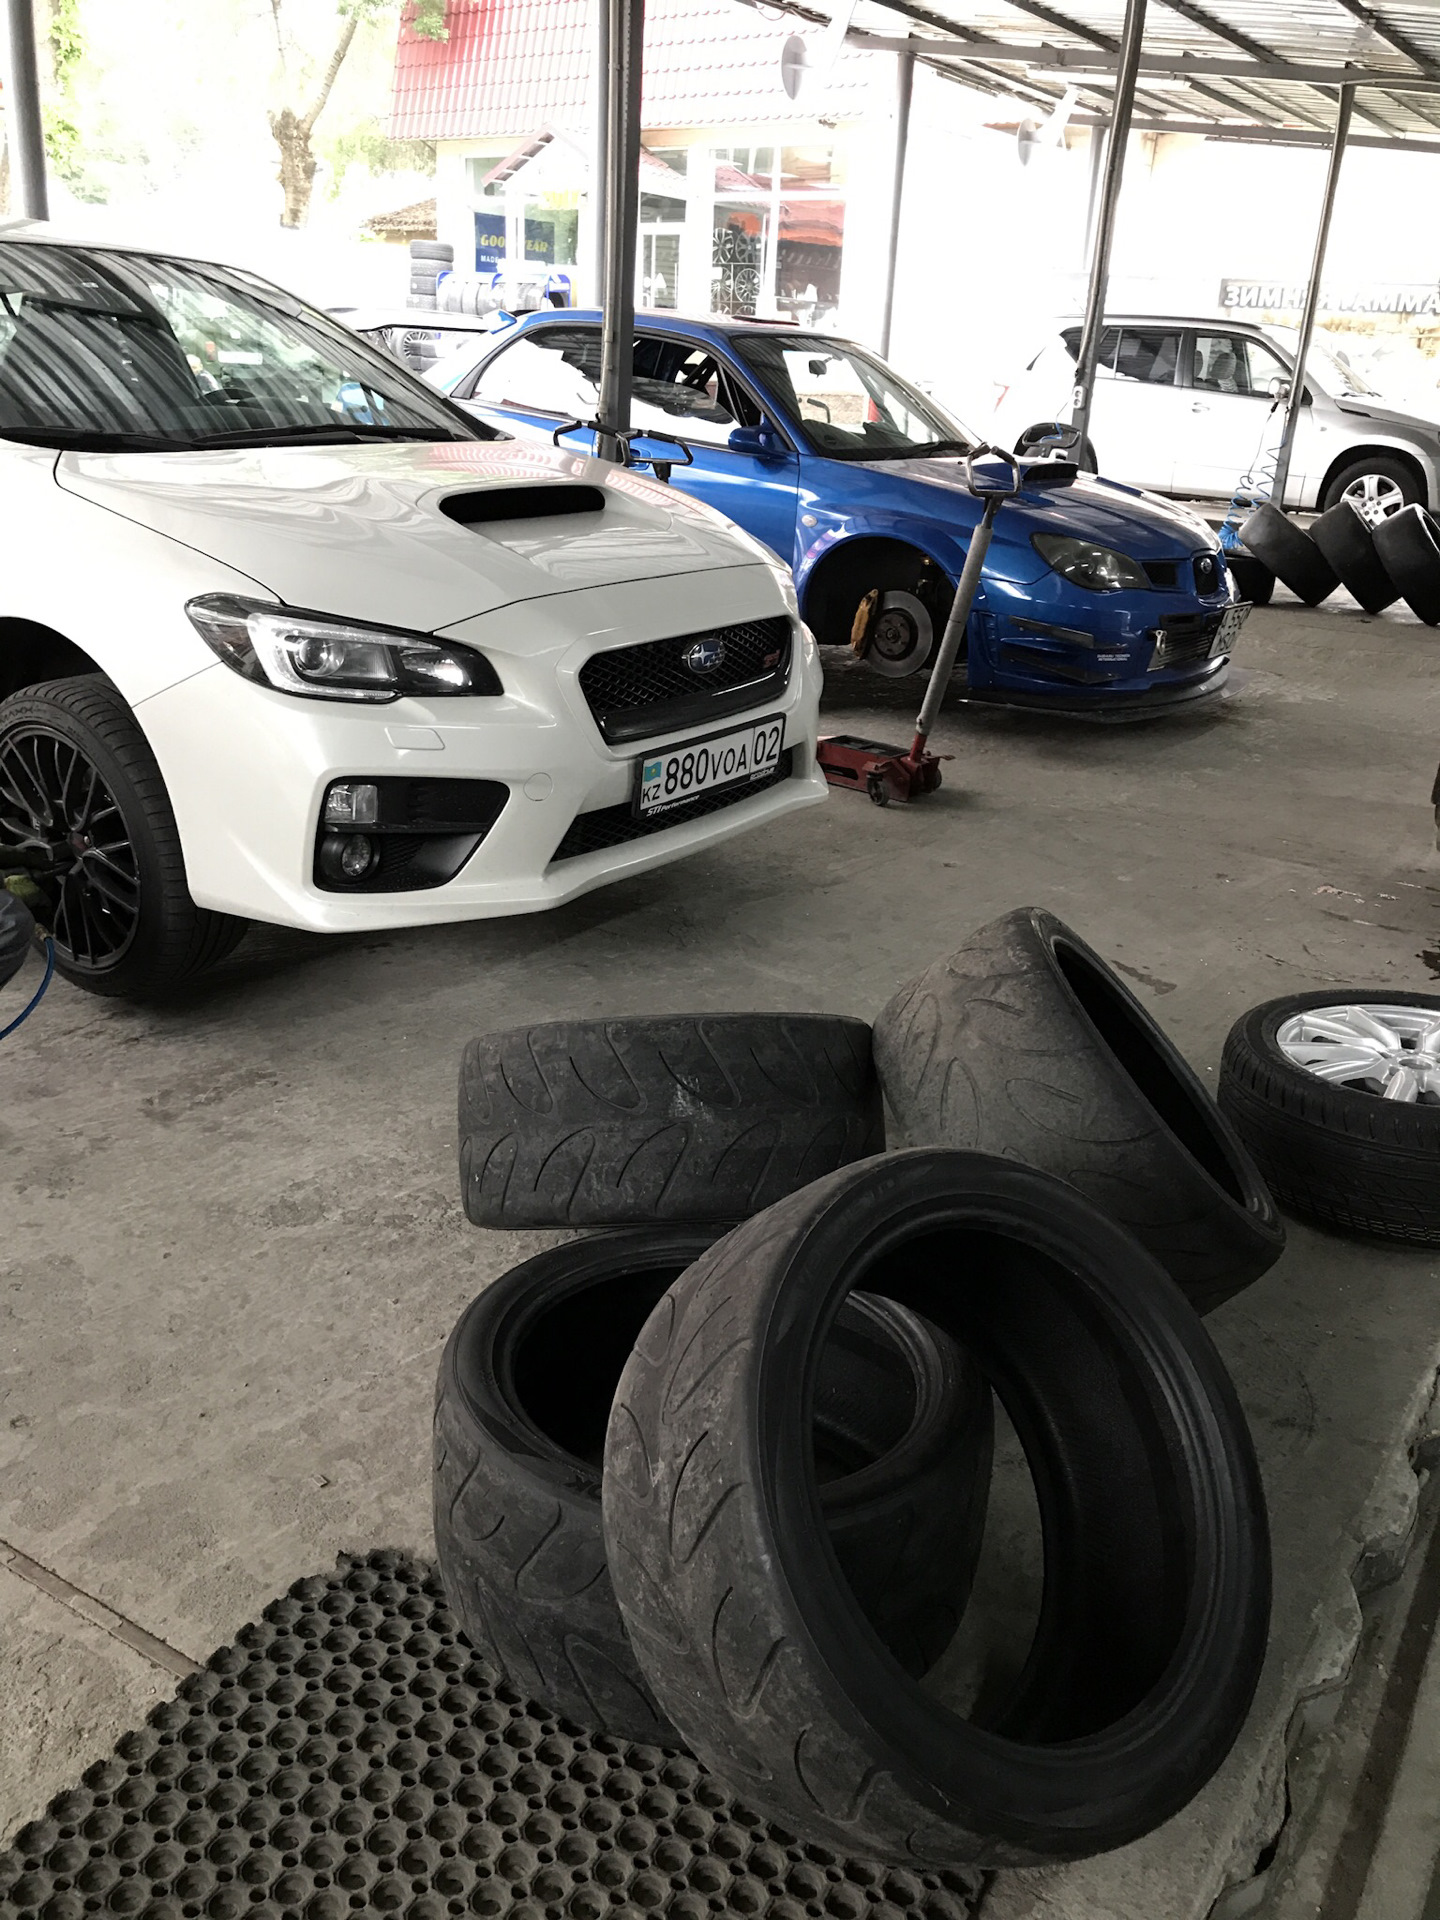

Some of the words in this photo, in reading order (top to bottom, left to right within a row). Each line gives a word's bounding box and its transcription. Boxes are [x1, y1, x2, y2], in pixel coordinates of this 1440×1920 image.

[481, 235, 549, 253] GOOEAR
[1225, 285, 1335, 310] ЗИМНЯ
[755, 727, 779, 765] 02
[642, 784, 661, 804] KZ
